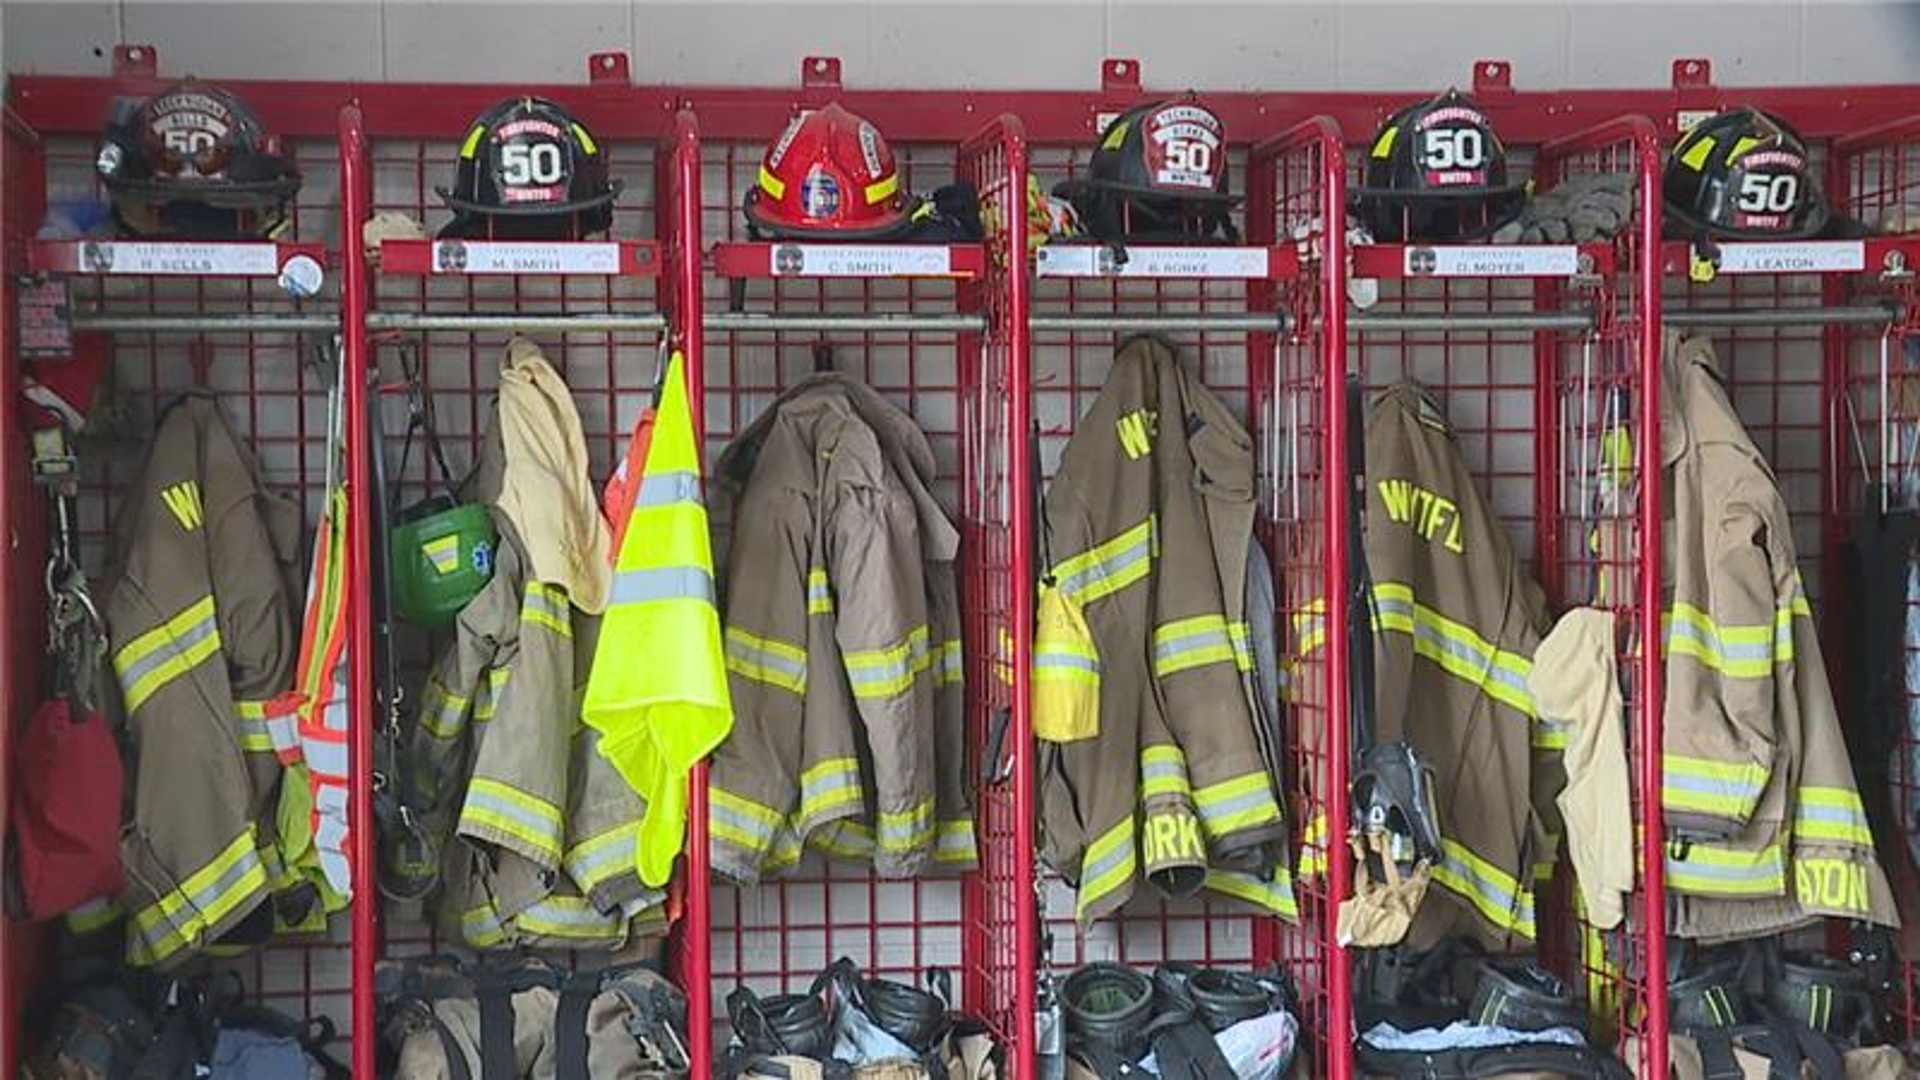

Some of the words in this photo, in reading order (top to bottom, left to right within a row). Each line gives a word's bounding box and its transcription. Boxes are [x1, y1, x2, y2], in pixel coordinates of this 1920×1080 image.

[1165, 140, 1211, 172] 50
[1425, 129, 1482, 169] 50
[502, 143, 560, 184] 50
[1739, 174, 1797, 212] 50
[513, 259, 561, 270] SMITH
[847, 261, 893, 273] SMITH
[1474, 262, 1525, 272] MOYER
[1755, 259, 1814, 269] LEATON
